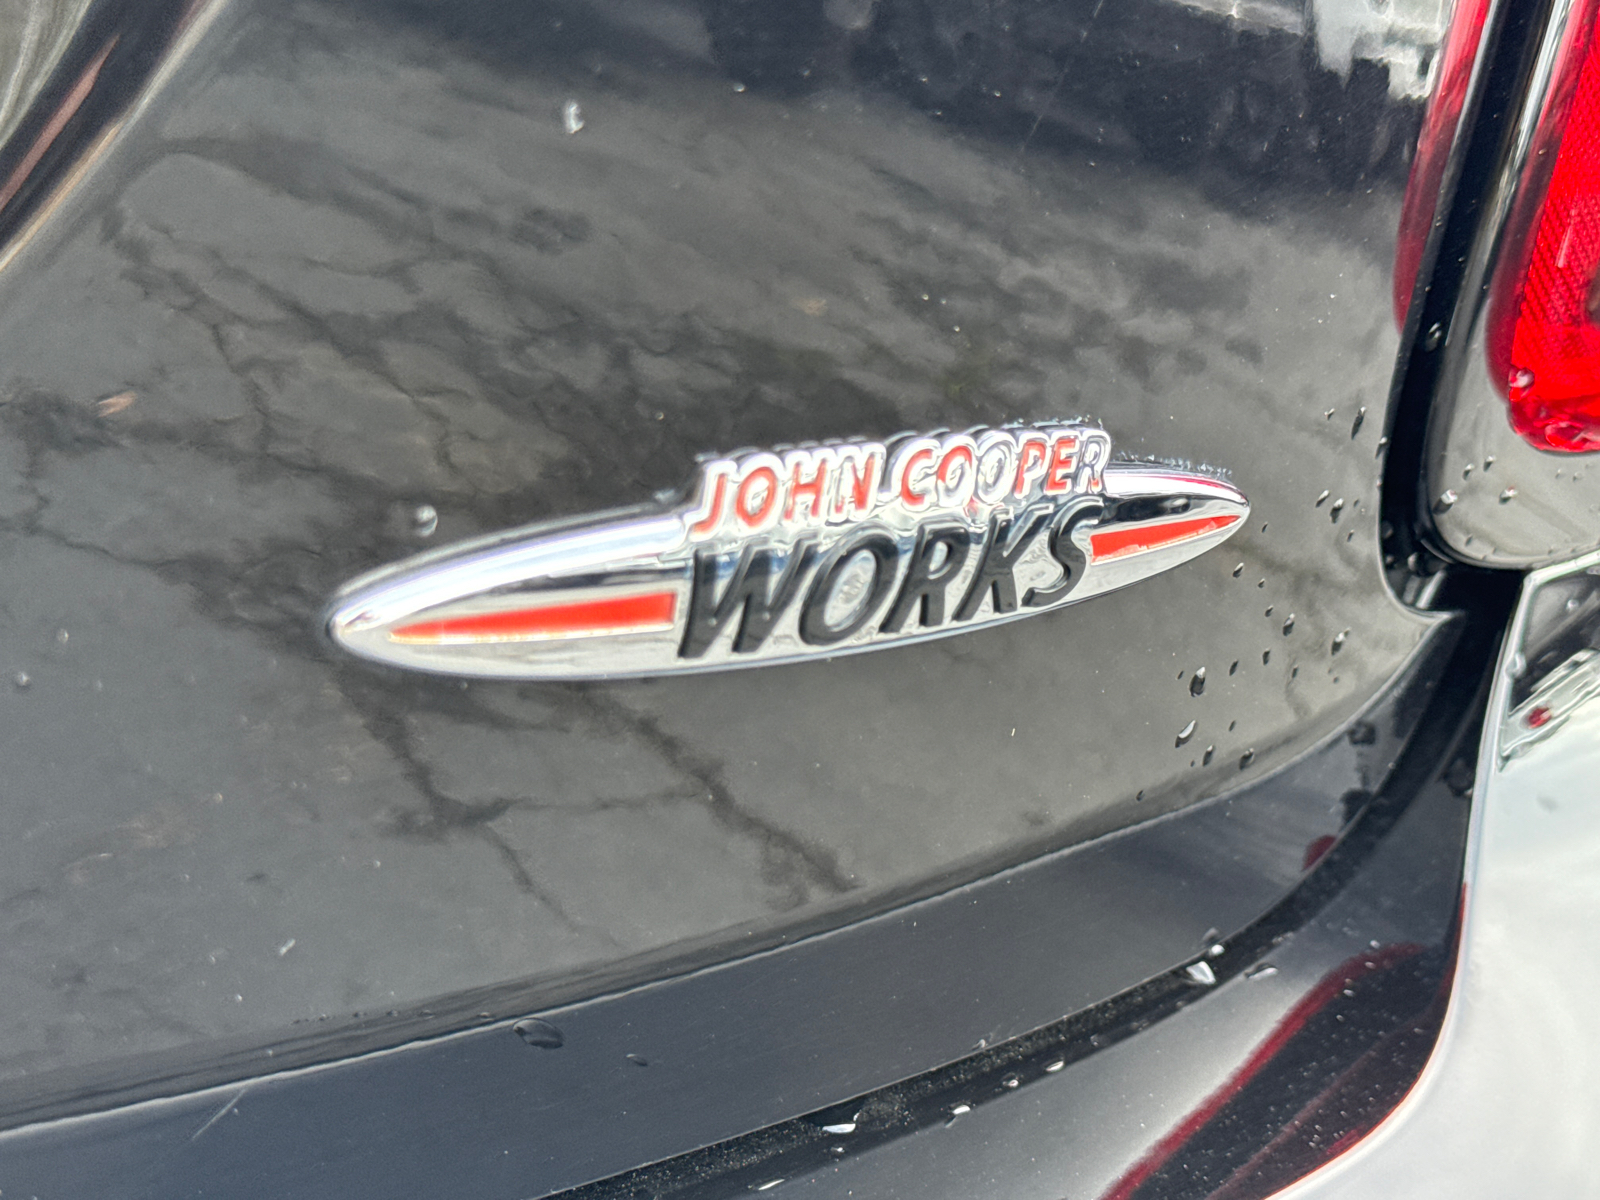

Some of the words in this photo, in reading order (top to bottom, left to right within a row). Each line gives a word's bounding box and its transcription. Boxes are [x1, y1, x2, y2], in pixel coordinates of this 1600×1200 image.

[690, 453, 880, 537] JOHN
[899, 435, 1106, 508] COOPER
[677, 498, 1104, 659] WORKS
